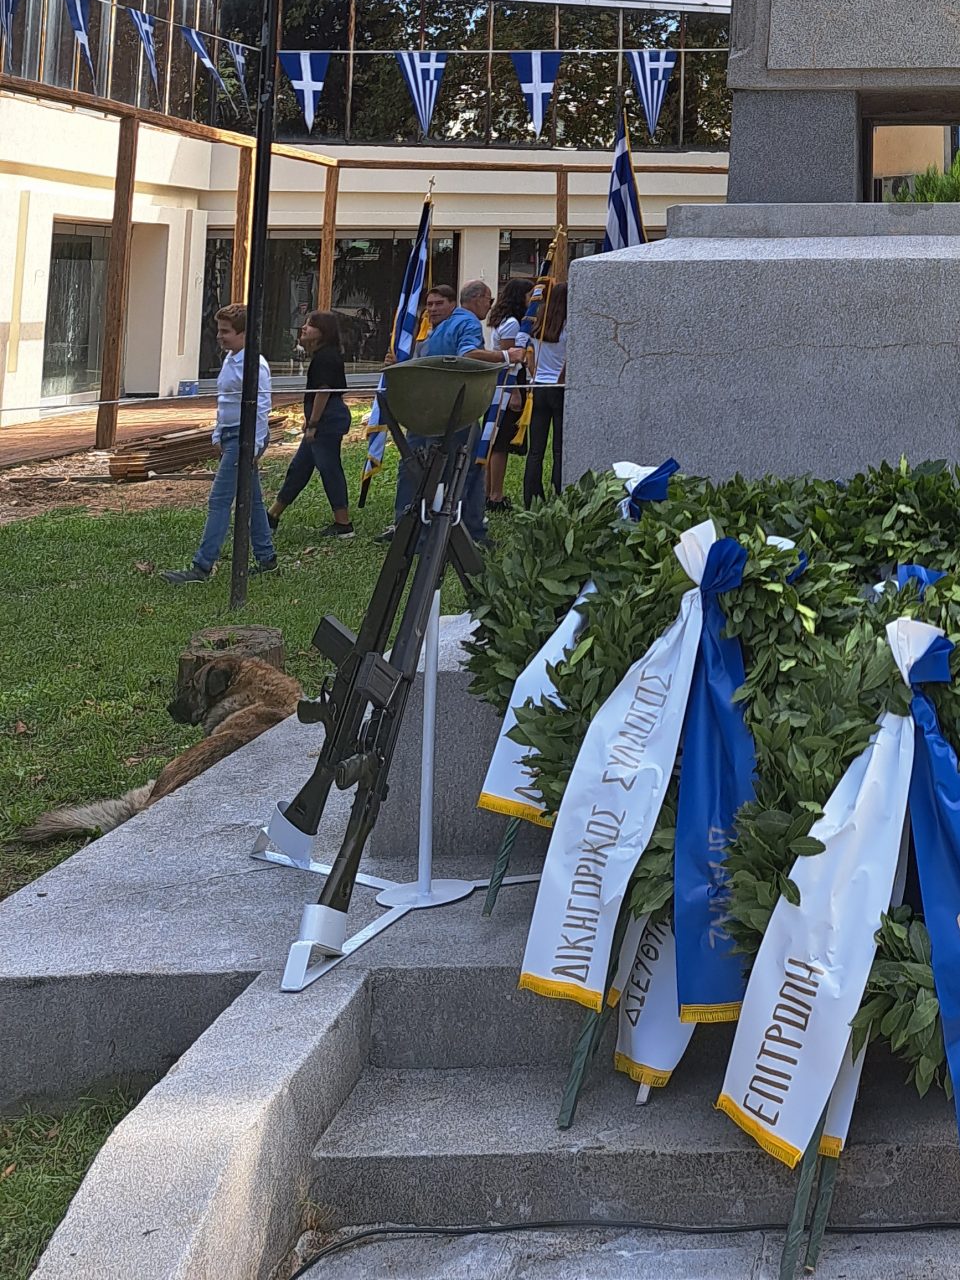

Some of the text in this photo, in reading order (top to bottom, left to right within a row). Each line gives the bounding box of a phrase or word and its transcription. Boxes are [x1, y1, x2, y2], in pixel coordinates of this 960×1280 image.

[551, 670, 673, 982] ΔΙΚΗΓΟΡΙΚΟΣ ΣΥΛΛΟΓΟΣ
[742, 958, 825, 1127] ΕΠΙΤΡΟΠΗ
